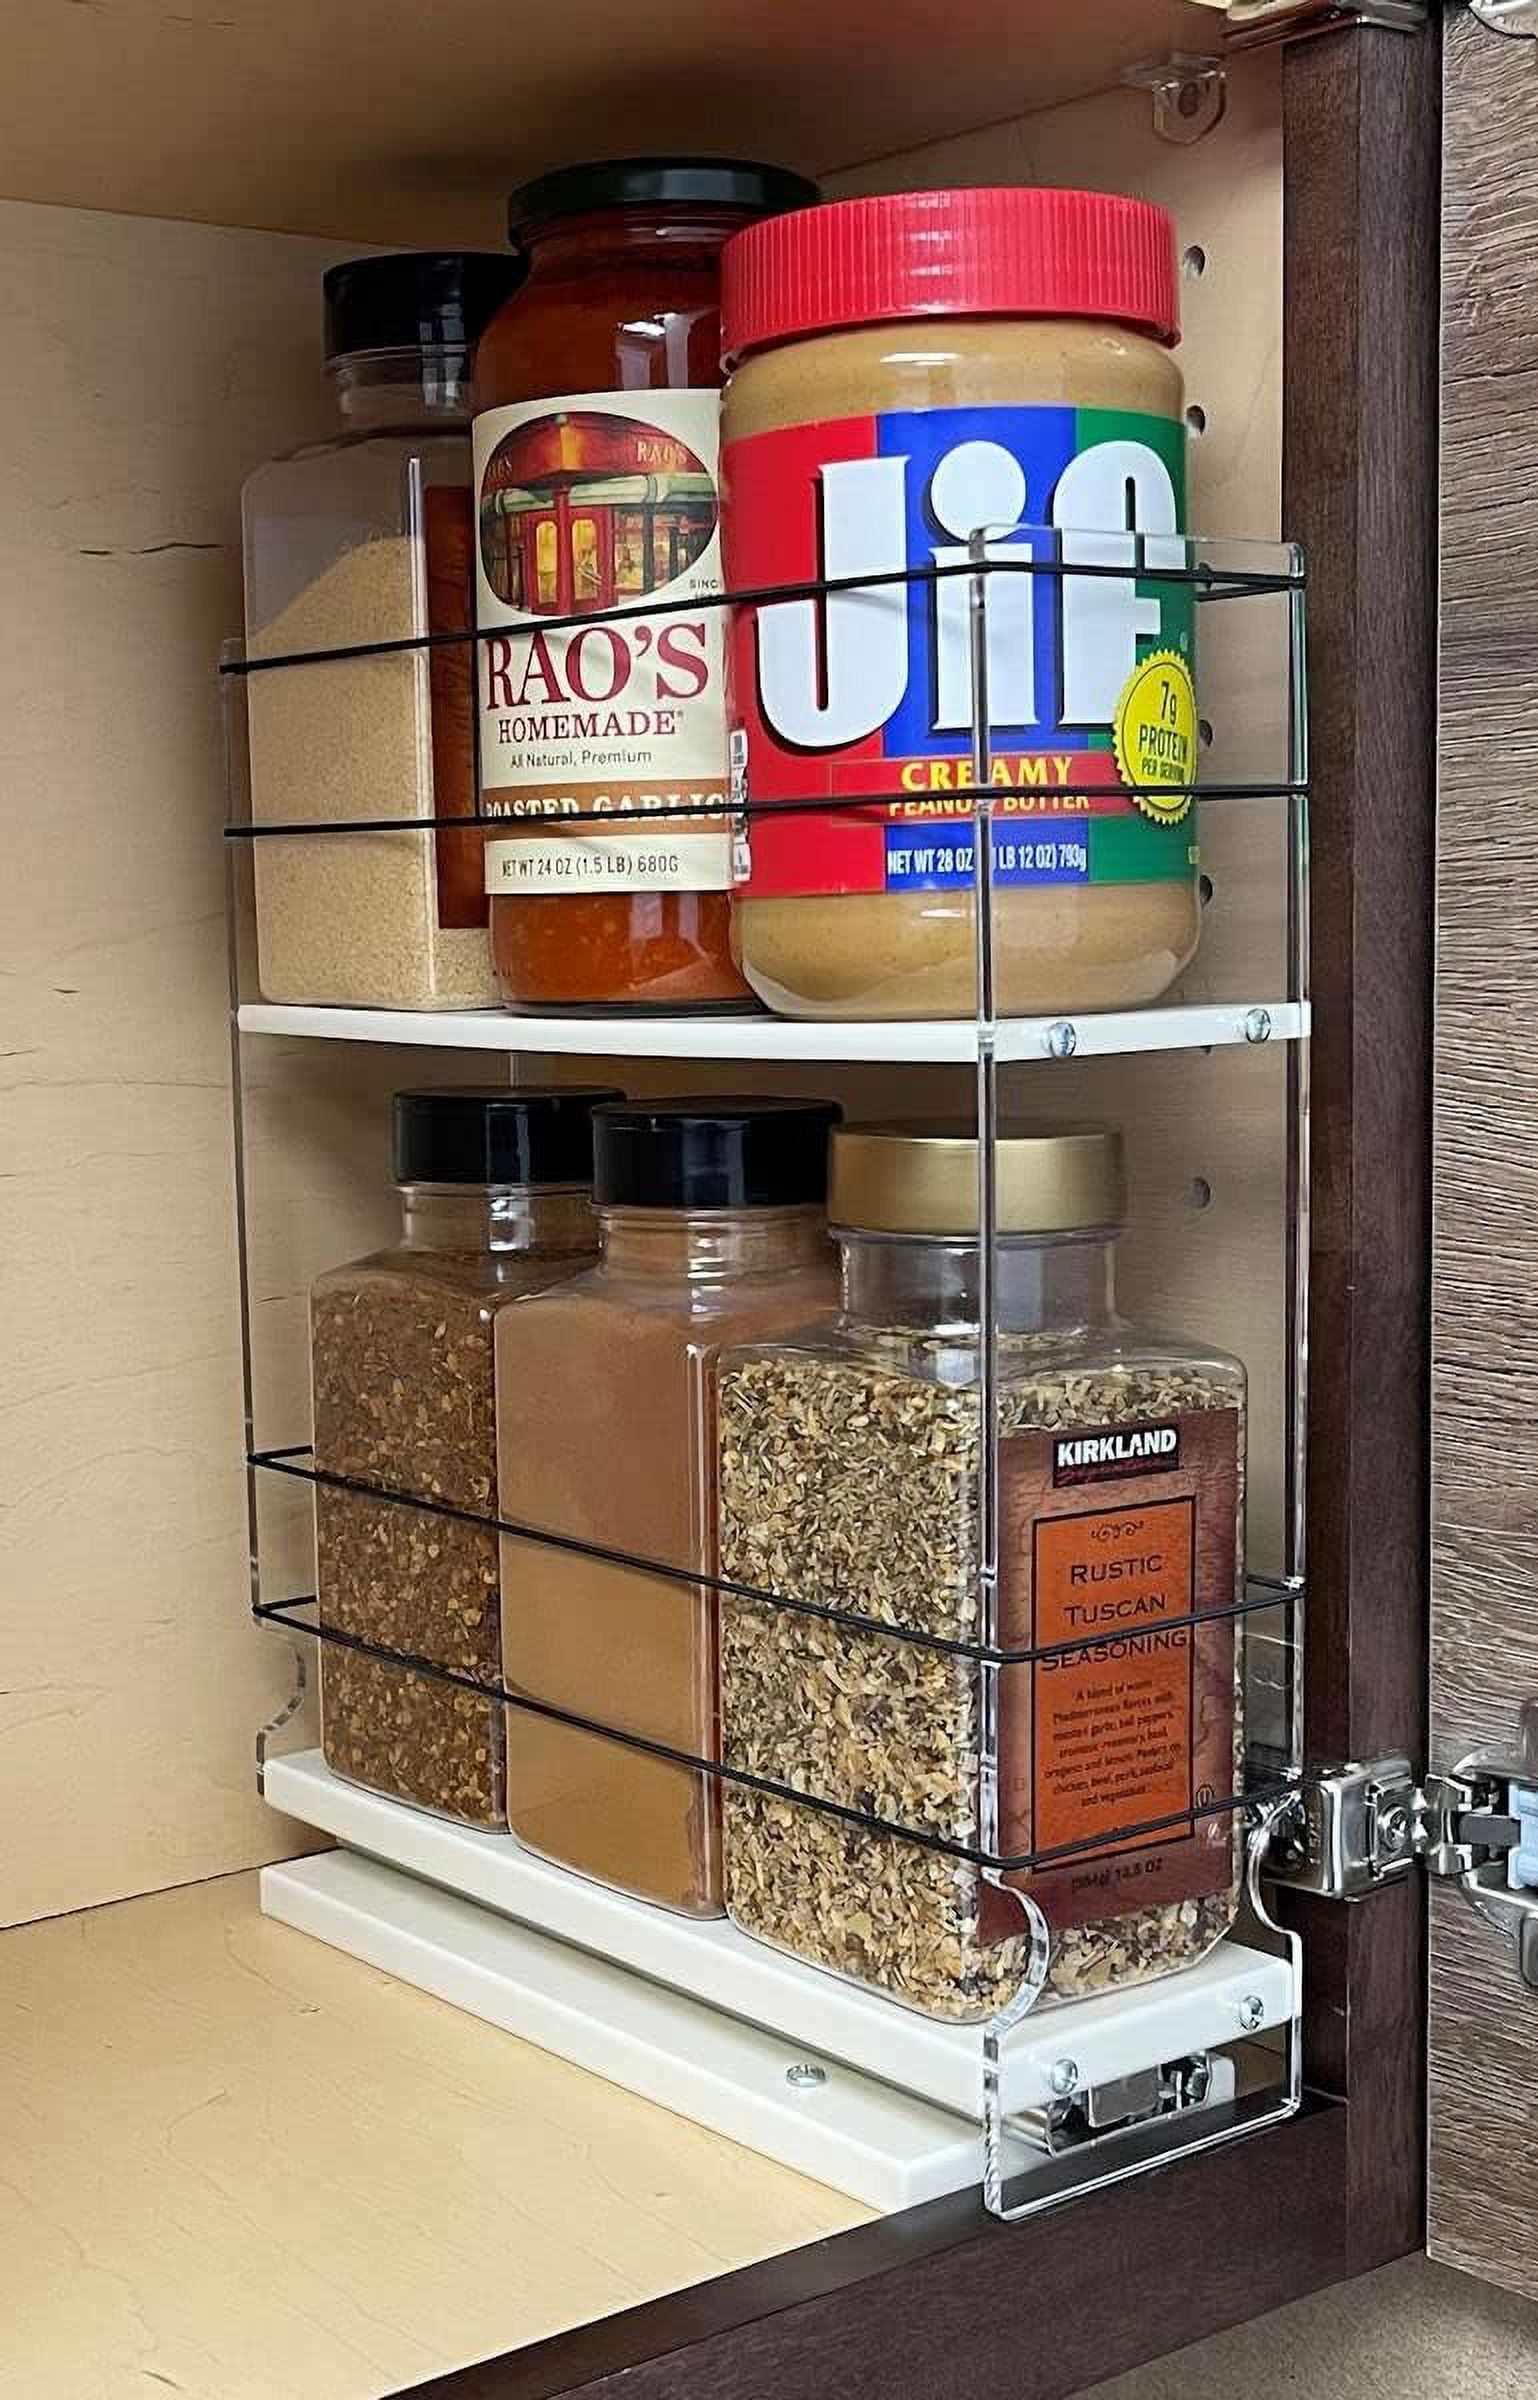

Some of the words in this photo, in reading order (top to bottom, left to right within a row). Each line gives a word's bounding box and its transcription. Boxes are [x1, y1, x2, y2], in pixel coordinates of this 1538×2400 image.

[689, 578, 722, 589] SINC
[755, 440, 1187, 748] Jif
[485, 623, 709, 710] RAO'S
[1161, 680, 1177, 726] 7g
[498, 710, 676, 744] HOMEMADE
[511, 753, 523, 769] All
[526, 751, 577, 767] Natural,
[581, 749, 652, 764] Premium
[901, 757, 1072, 792] CREAMY
[888, 797, 979, 817] PEANU
[502, 859, 517, 877] NET
[518, 858, 534, 876] WT
[537, 858, 551, 875] 24
[555, 857, 572, 874] OZ
[575, 856, 603, 876] (1.5
[607, 856, 633, 875] LB)
[637, 855, 680, 873] 680G
[887, 850, 912, 875] NET
[913, 849, 936, 874] WT
[937, 847, 954, 873] 28
[955, 846, 975, 872] OZ
[999, 845, 1016, 870] LB
[1019, 845, 1034, 870] 12
[1057, 1429, 1178, 1467] KIRKLAND
[1070, 1555, 1163, 1586] RUSTIC
[1064, 1593, 1166, 1627] TUSCAN
[1041, 1629, 1188, 1672] SEASONING
